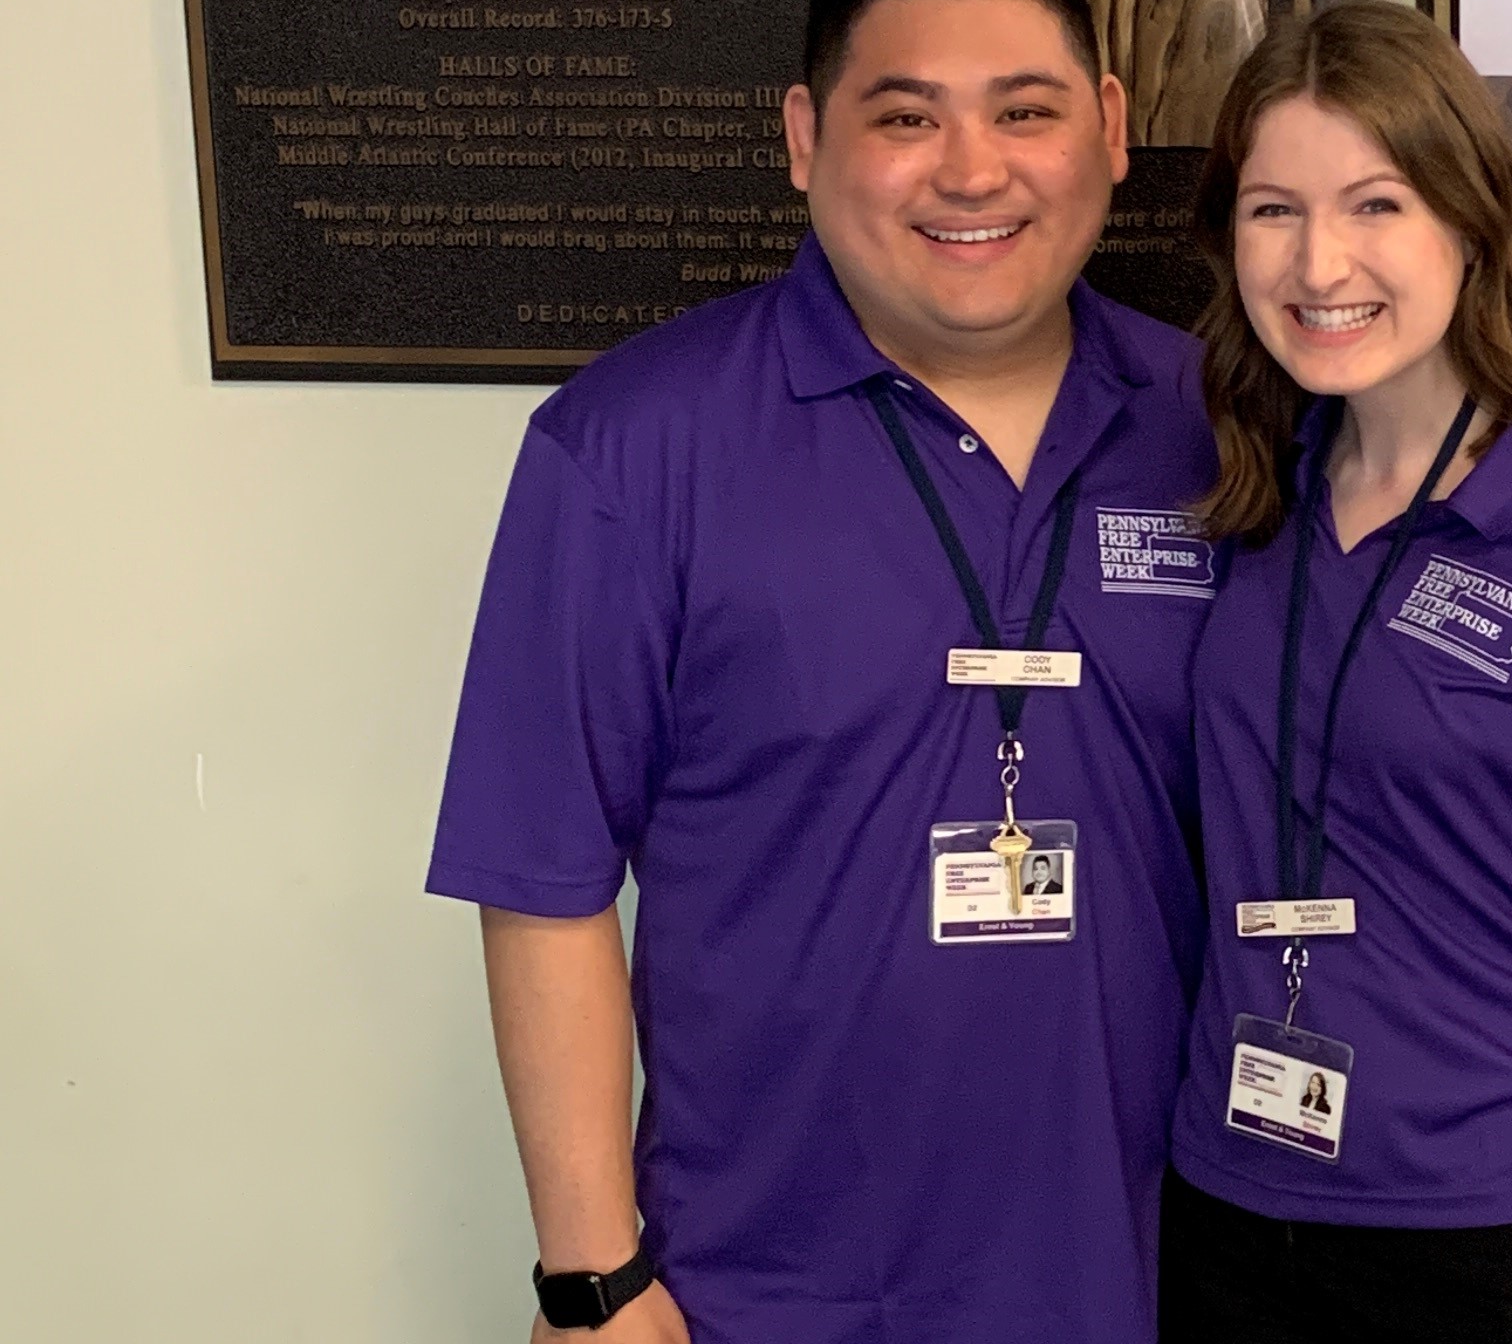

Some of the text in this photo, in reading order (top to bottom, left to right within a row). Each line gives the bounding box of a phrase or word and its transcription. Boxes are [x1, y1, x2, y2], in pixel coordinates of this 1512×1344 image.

[399, 8, 672, 28] Overall Record: 376-173-5
[440, 56, 637, 76] HALLS OF FAME:
[235, 85, 781, 110] National Wrestling Coaches Association Division III
[273, 116, 783, 142] National Wrestling Hall of Fame (PA Chapter, 19
[278, 144, 790, 172] Middle Atlantic Conference (2012, Inaugural Cla
[365, 204, 391, 223] my
[400, 203, 446, 225] guys
[452, 205, 548, 226] graduated
[571, 206, 627, 222] would
[635, 206, 674, 226] stay
[683, 205, 699, 222] in
[708, 205, 762, 222] touch
[771, 206, 809, 222] with
[337, 230, 374, 246] was
[382, 228, 435, 247] proud
[445, 228, 478, 245] and
[501, 232, 555, 247] would
[564, 232, 607, 252] brag
[615, 232, 668, 248] about
[739, 232, 752, 248] It
[760, 234, 798, 249] was
[681, 264, 792, 282] Budd Whit
[1097, 514, 1206, 534] PENNSYLV
[1098, 530, 1141, 547] FREE
[1100, 547, 1198, 567] ENTERPRISE
[1101, 563, 1150, 579] WEEK
[1414, 575, 1455, 599] FREE
[1397, 604, 1442, 630] WEEK
[1405, 590, 1502, 641] ENTERPRISE
[1024, 655, 1051, 663] CODY
[1023, 665, 1051, 674] CHAN
